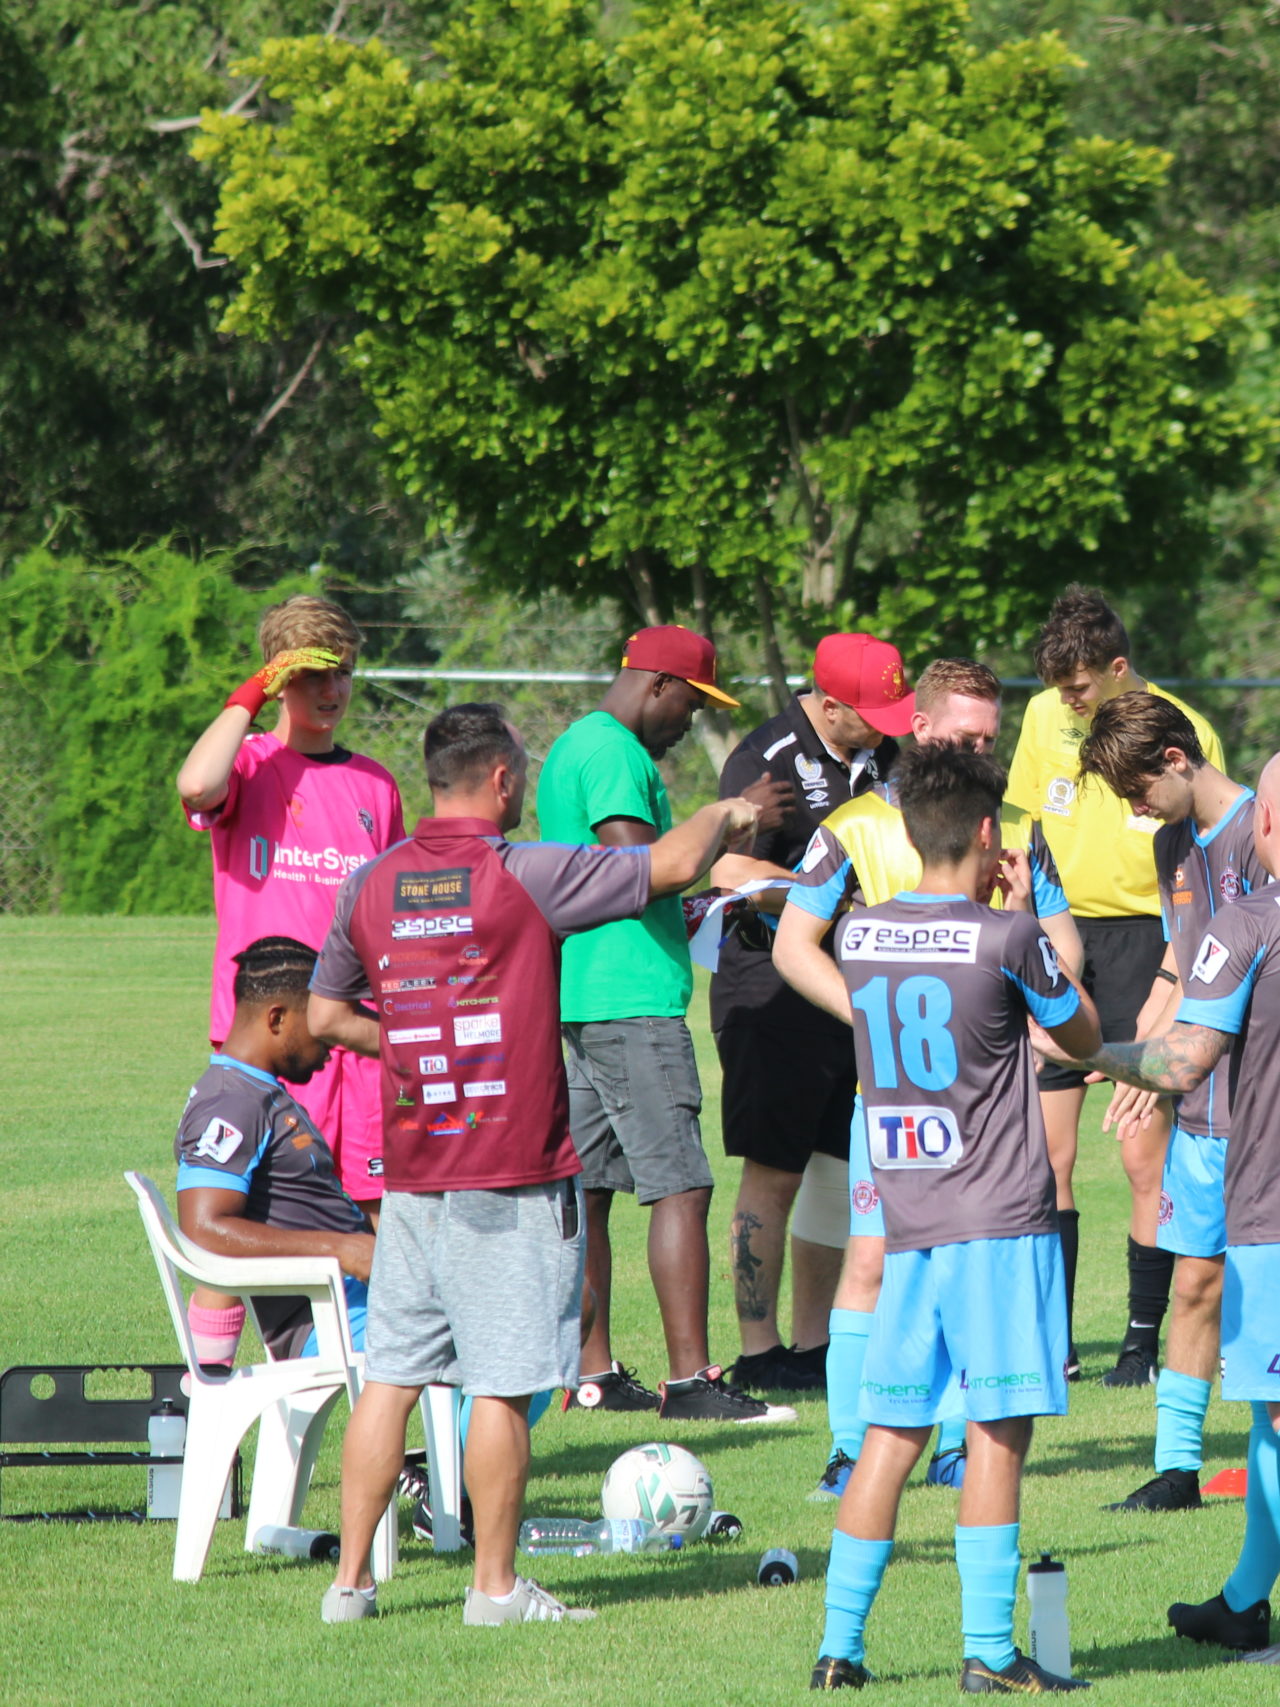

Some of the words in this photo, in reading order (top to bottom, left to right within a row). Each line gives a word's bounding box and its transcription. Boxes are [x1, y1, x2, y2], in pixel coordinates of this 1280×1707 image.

[273, 841, 367, 875] InterSyst
[273, 869, 306, 883] Health
[400, 884, 429, 897] STONE
[432, 882, 461, 895] HOUSE
[393, 917, 473, 936] espec
[876, 929, 971, 949] espec
[851, 975, 958, 1091] 18
